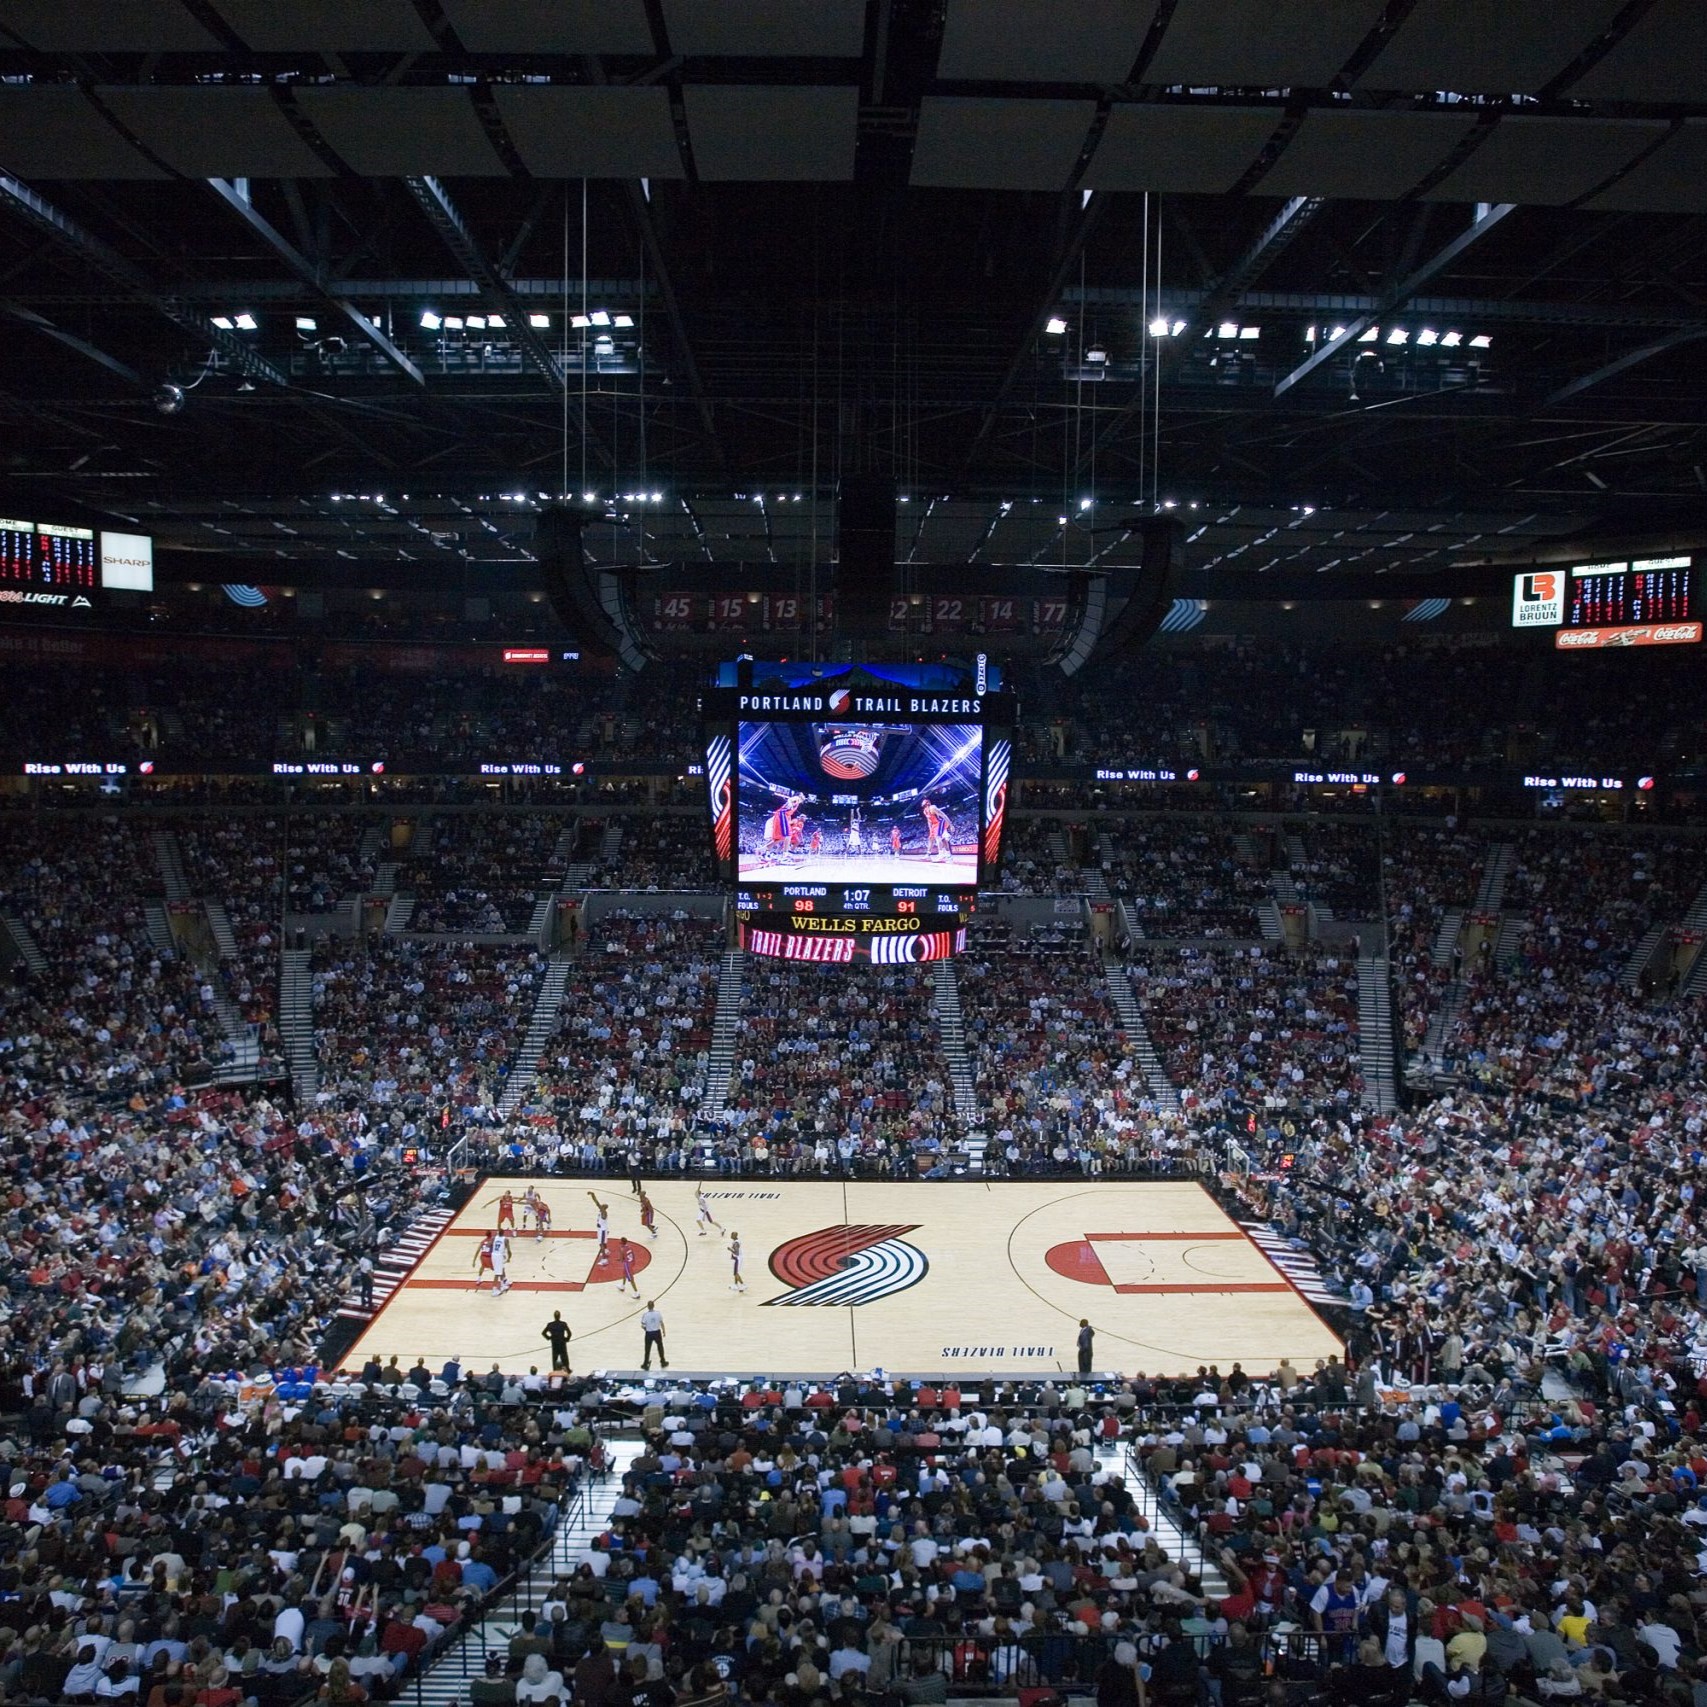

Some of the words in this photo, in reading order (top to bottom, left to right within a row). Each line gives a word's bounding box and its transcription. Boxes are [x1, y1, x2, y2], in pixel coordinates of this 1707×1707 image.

[103, 556, 150, 568] SHARP
[23, 592, 68, 605] LIGHT
[664, 598, 690, 617] 45
[720, 599, 743, 617] 15
[775, 600, 797, 618] 13
[936, 600, 962, 620] 22
[991, 601, 1013, 619] 14
[1043, 603, 1067, 622] 77
[1520, 602, 1558, 612] LORENTZ
[1520, 611, 1557, 621] BRUUN
[740, 696, 823, 711] PORTLAND
[856, 698, 902, 711] TRAIL
[911, 700, 981, 713] BLAZERS
[25, 763, 60, 774] Rise
[66, 763, 101, 774] With
[106, 763, 126, 774] Us
[273, 764, 303, 773] Rise
[307, 764, 338, 773] With
[342, 764, 360, 773] Us
[481, 764, 508, 773] Rise
[512, 764, 540, 773] With
[545, 765, 561, 774] Us
[1097, 770, 1123, 780] Rise
[1127, 770, 1156, 780] With
[1160, 771, 1175, 780] Us
[1295, 773, 1322, 783] Rise
[1328, 773, 1358, 783] With
[1362, 774, 1379, 784] Us
[1524, 777, 1557, 787] Rise
[1562, 777, 1596, 788] With
[1603, 779, 1623, 788] Us
[784, 886, 827, 896] PORTLAND
[844, 890, 870, 901] 1:07
[893, 888, 928, 897] DETROIT
[795, 900, 814, 911] 98
[898, 902, 915, 912] 91
[791, 916, 856, 932] WELLS
[862, 918, 920, 932] FARGO
[752, 929, 782, 956] TRAIL
[785, 934, 855, 962] BLAZERS
[378, 1208, 456, 1265] BLAZERS
[942, 1347, 1005, 1357] BLAZERS
[1012, 1346, 1054, 1356] TRAIL
